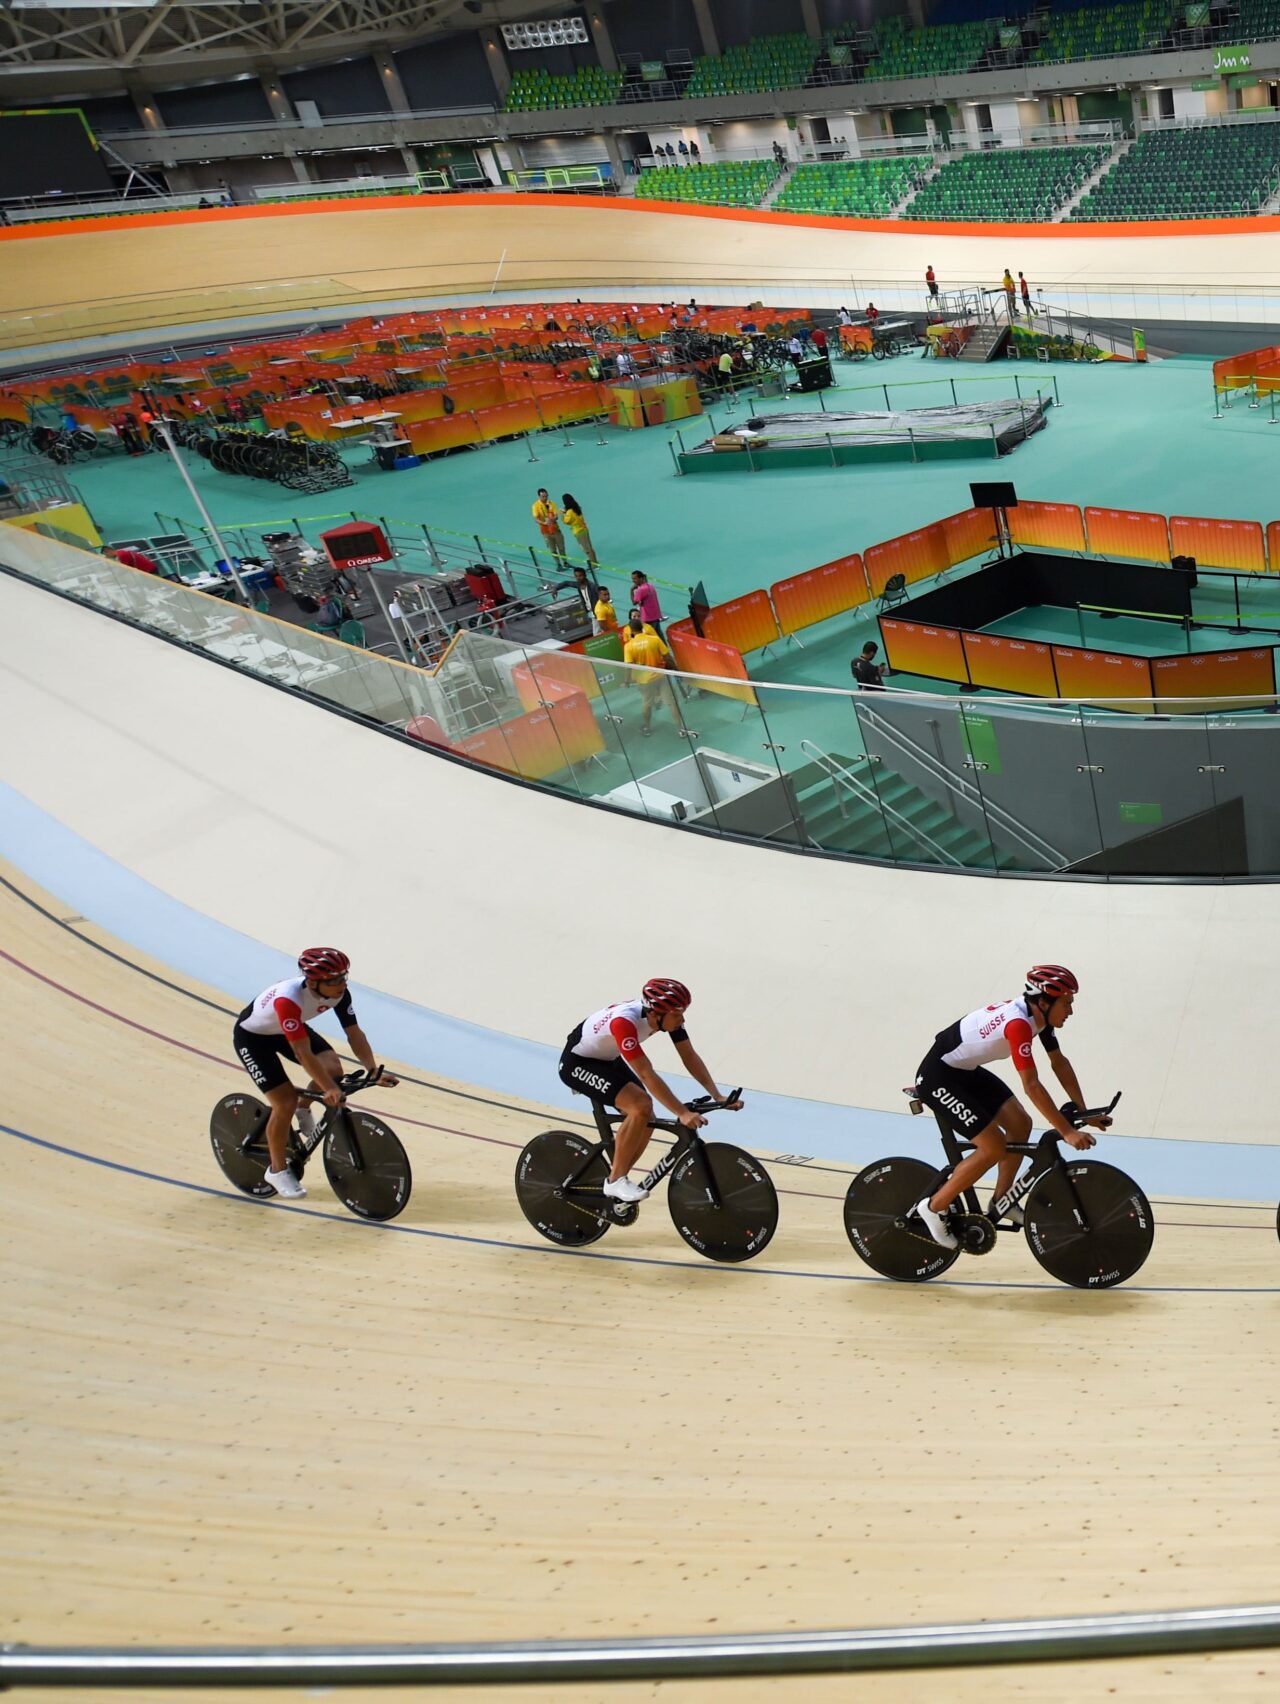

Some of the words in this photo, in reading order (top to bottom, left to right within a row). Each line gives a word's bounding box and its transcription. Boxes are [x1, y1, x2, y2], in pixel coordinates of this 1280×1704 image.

[356, 556, 384, 565] OMEGA
[979, 1012, 1006, 1039] SUISSE
[239, 1047, 267, 1085] SUISSE
[571, 1066, 612, 1095] SUISSE
[932, 1087, 978, 1127] SUISSE
[641, 1156, 676, 1191] BMC
[995, 1168, 1035, 1216] BMC
[927, 1257, 944, 1273] SWISS
[1088, 1276, 1100, 1284] DT
[1101, 1270, 1121, 1282] SWISS
